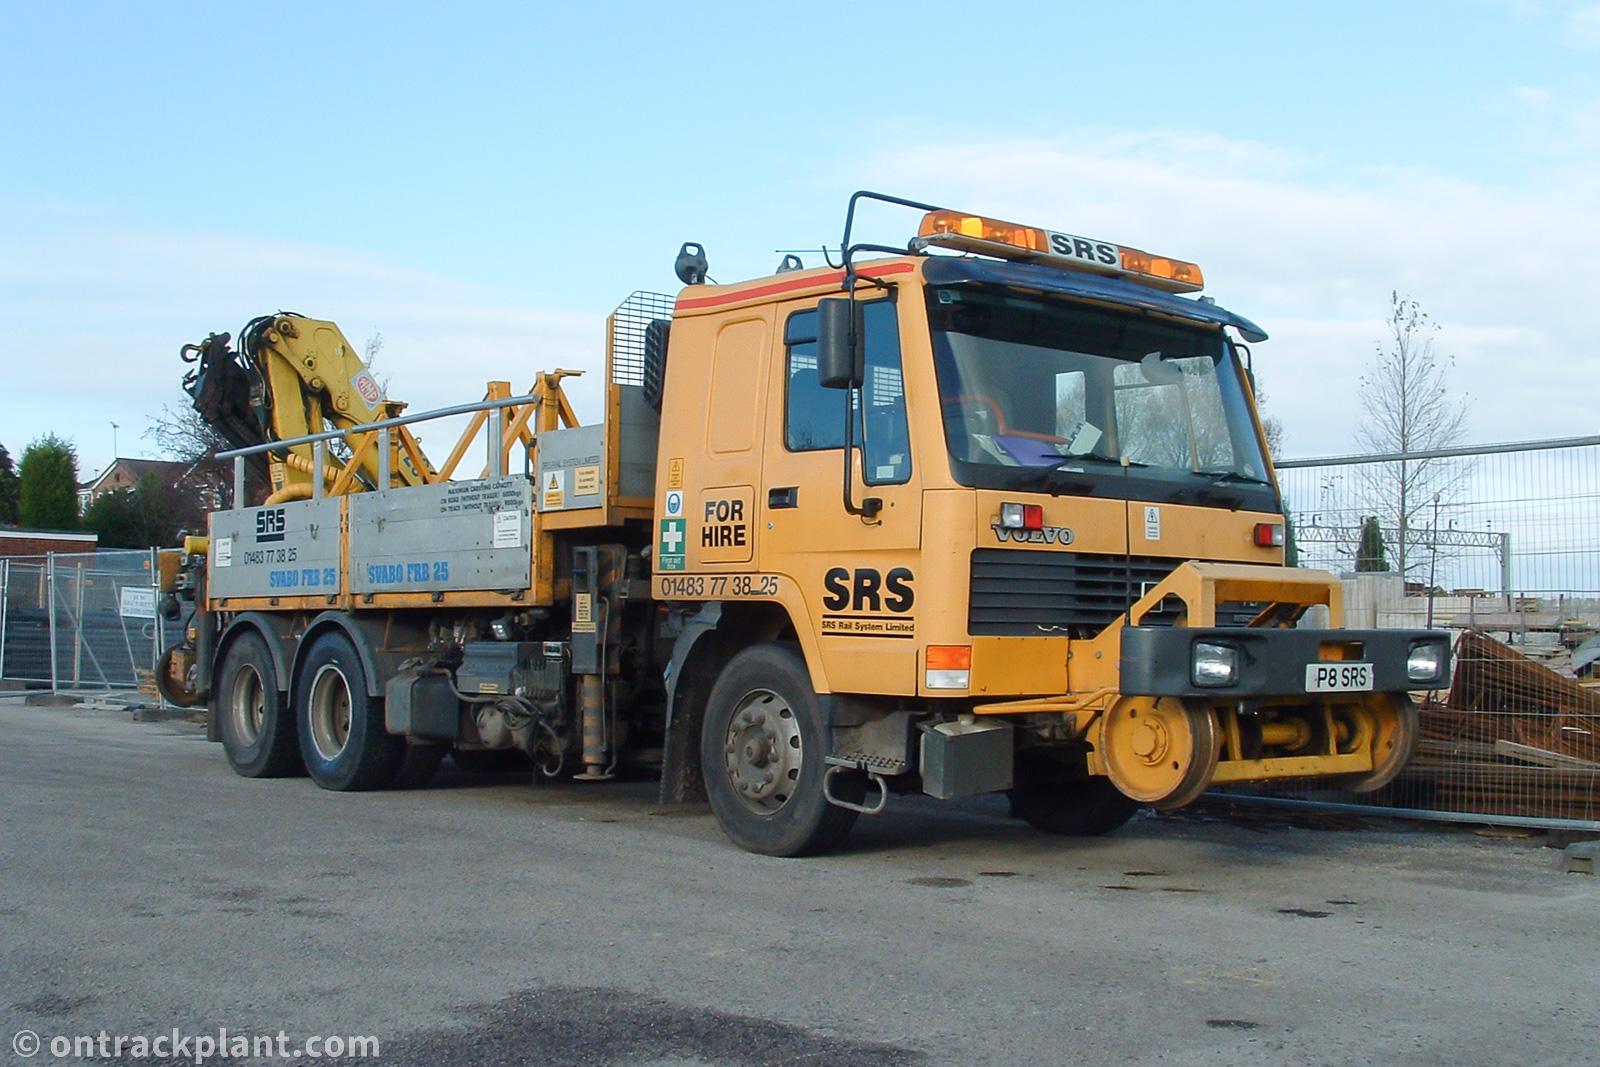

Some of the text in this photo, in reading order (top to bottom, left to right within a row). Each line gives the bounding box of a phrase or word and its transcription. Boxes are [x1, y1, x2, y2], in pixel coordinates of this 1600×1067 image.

[1051, 234, 1116, 265] SRS
[256, 508, 285, 533] SRS
[704, 500, 744, 522] FOR
[702, 524, 746, 547] HIRE
[991, 524, 1074, 545] VOLVO
[244, 550, 264, 564] 01483
[266, 550, 274, 562] 77
[276, 548, 285, 562] 38
[288, 548, 297, 562] 25
[270, 568, 336, 588] SVABO FRB 25
[368, 562, 448, 584] SVABO FRB 25
[662, 576, 778, 596] 01483 77 38 25
[823, 567, 914, 612] SRS
[822, 621, 914, 631] SRS Rail System Limited
[1317, 667, 1366, 688] P8 SRS
